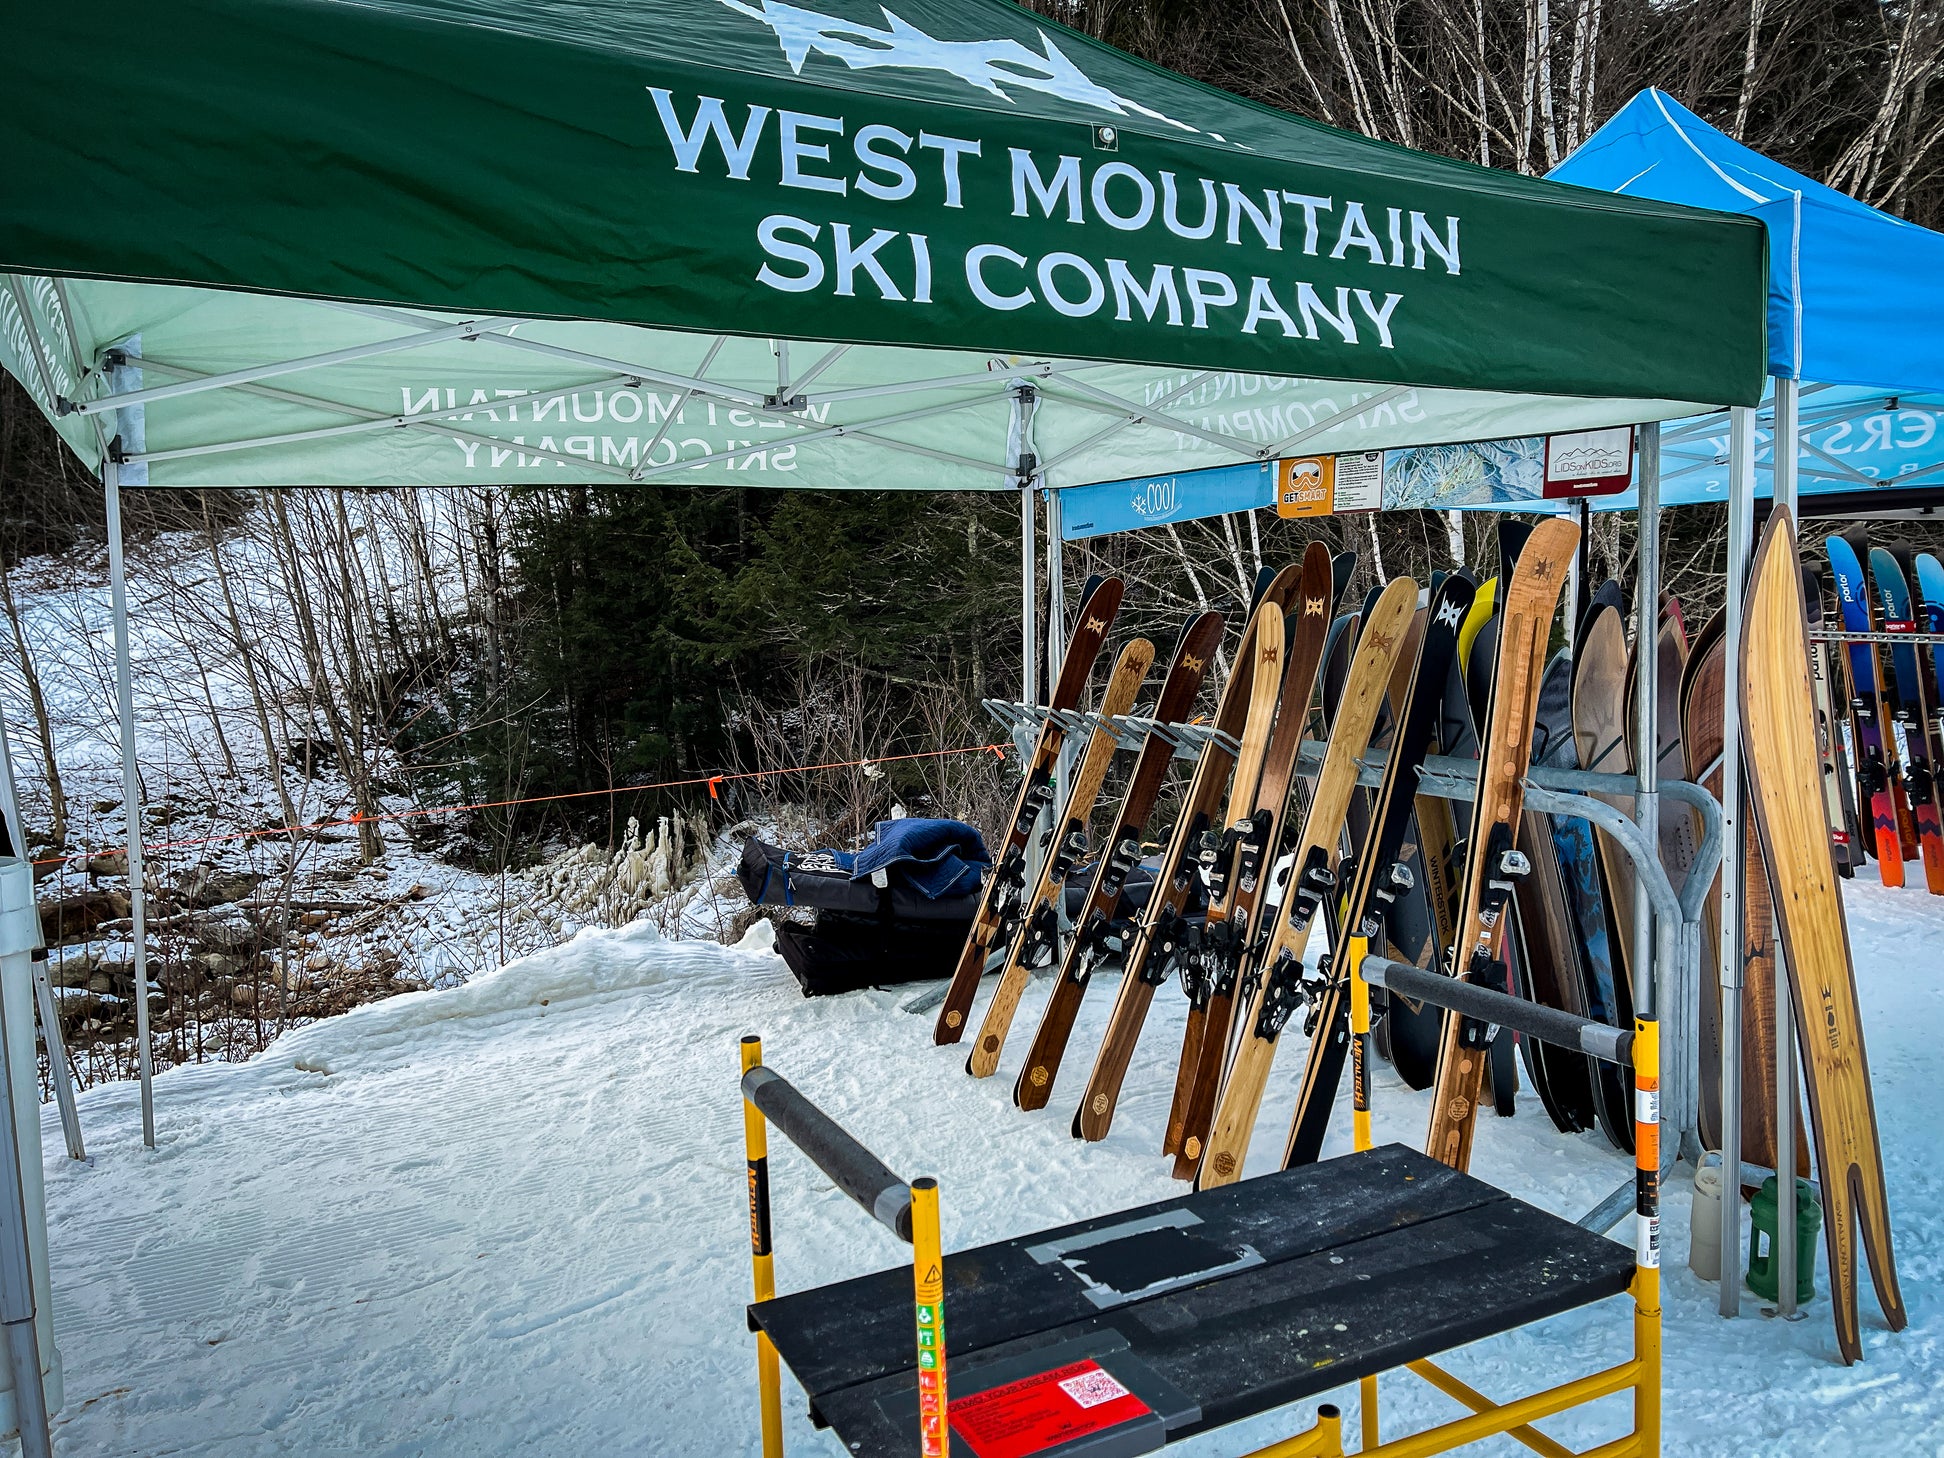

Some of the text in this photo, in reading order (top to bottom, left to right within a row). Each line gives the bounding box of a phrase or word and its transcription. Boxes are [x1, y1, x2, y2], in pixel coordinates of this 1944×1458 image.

[645, 86, 1461, 276] WEST MOUNTAIN
[754, 214, 1404, 349] SKI COMPANY
[1838, 573, 1854, 602] parlor
[1883, 588, 1900, 619] parlor
[1430, 855, 1450, 936] WINTERSTICK
[1353, 1038, 1364, 1104] METALTECH
